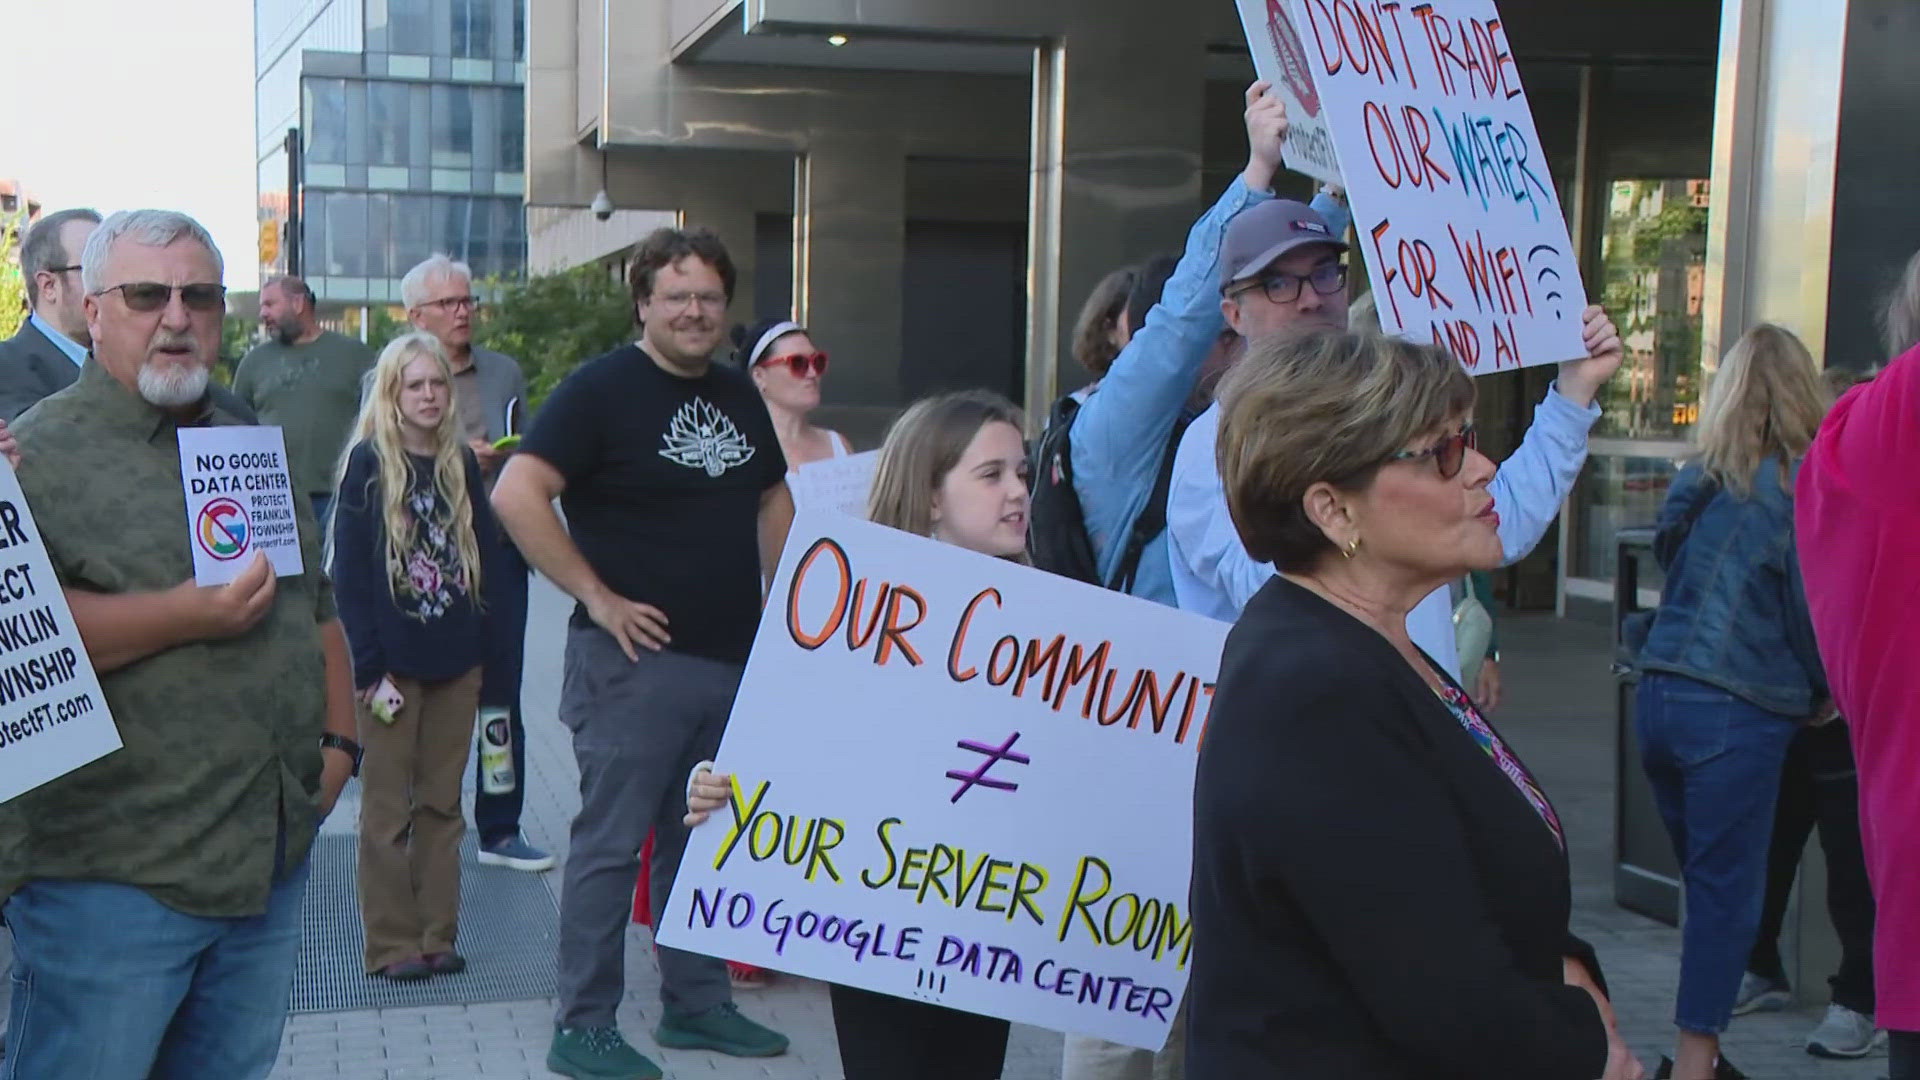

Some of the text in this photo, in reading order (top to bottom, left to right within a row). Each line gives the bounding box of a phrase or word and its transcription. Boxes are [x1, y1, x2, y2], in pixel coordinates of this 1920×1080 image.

[1306, 0, 1521, 100] DON'T TRADE
[1364, 101, 1550, 222] OUR WATER
[1371, 218, 1533, 328] FOR WIFI
[1431, 318, 1522, 370] AND AI
[191, 473, 288, 494] DATA CENTER
[196, 453, 279, 472] NO GOOGLE
[251, 494, 287, 507] PROTECT
[251, 507, 291, 522] FRANKLIN
[251, 522, 294, 537] TOWNSHIP
[786, 537, 927, 666] OUR
[712, 772, 1193, 970] YOUR SERVER ROOM
[688, 887, 1173, 1023] NO GOOGLE DATA CENTER
